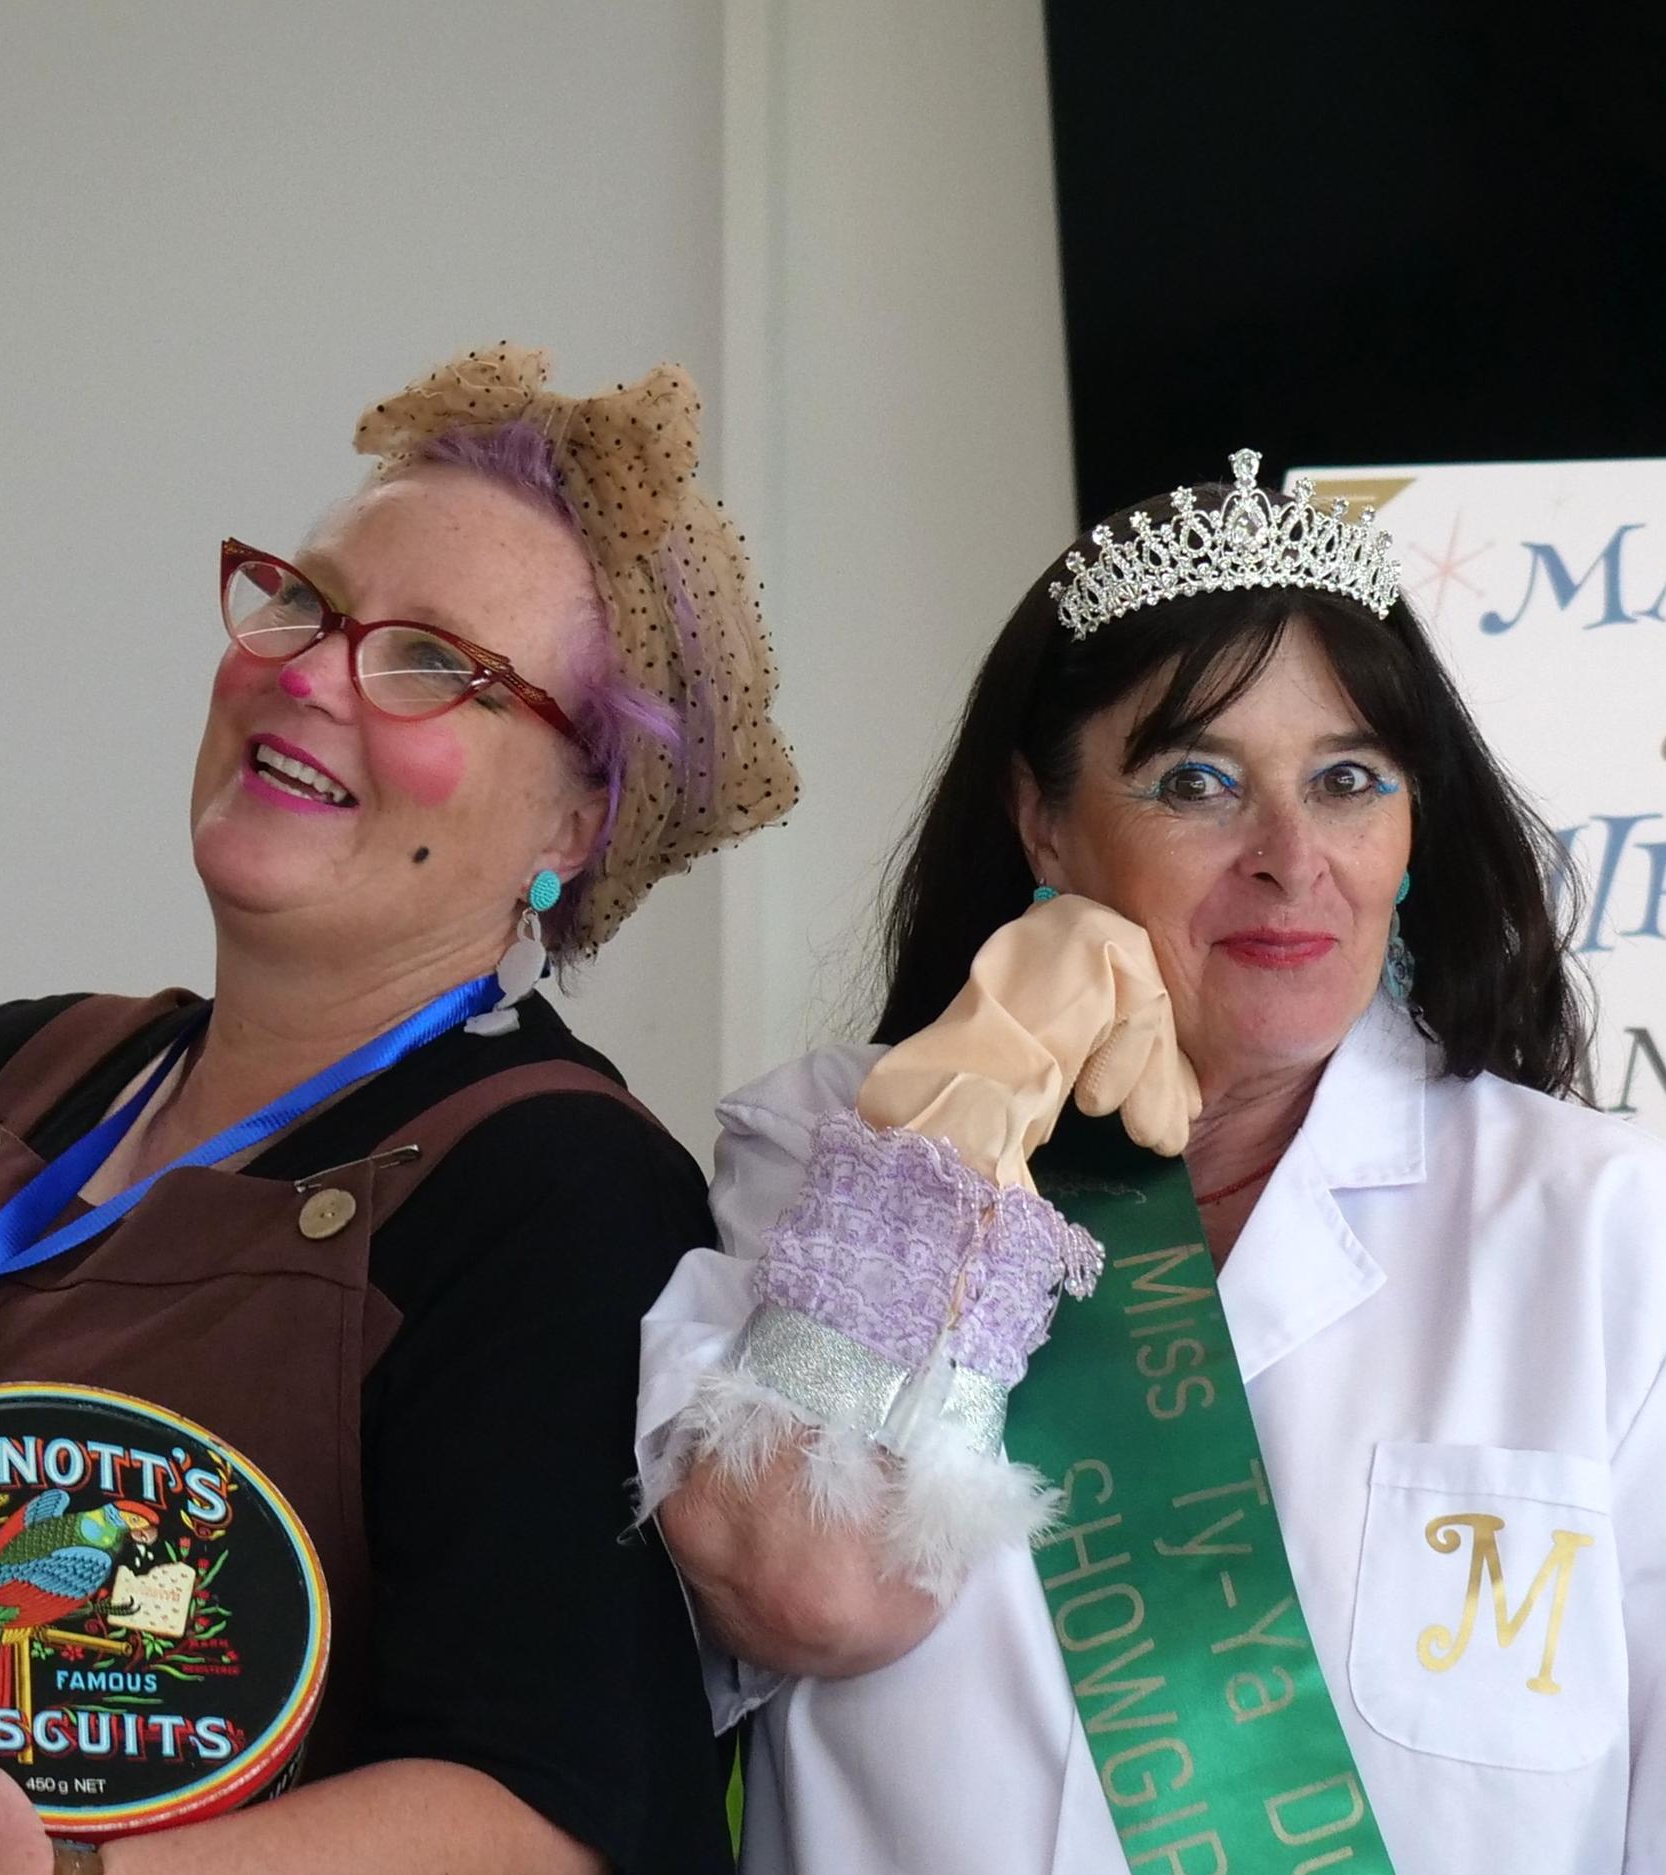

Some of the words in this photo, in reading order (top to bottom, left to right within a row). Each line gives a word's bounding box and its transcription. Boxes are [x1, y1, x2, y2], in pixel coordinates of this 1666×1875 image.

[1113, 1243, 1221, 1420] Miss
[1153, 1456, 1307, 1725] Ty-Ya
[1416, 1513, 1595, 1696] M
[56, 1669, 158, 1693] FAMOUS
[74, 1778, 107, 1794] NET
